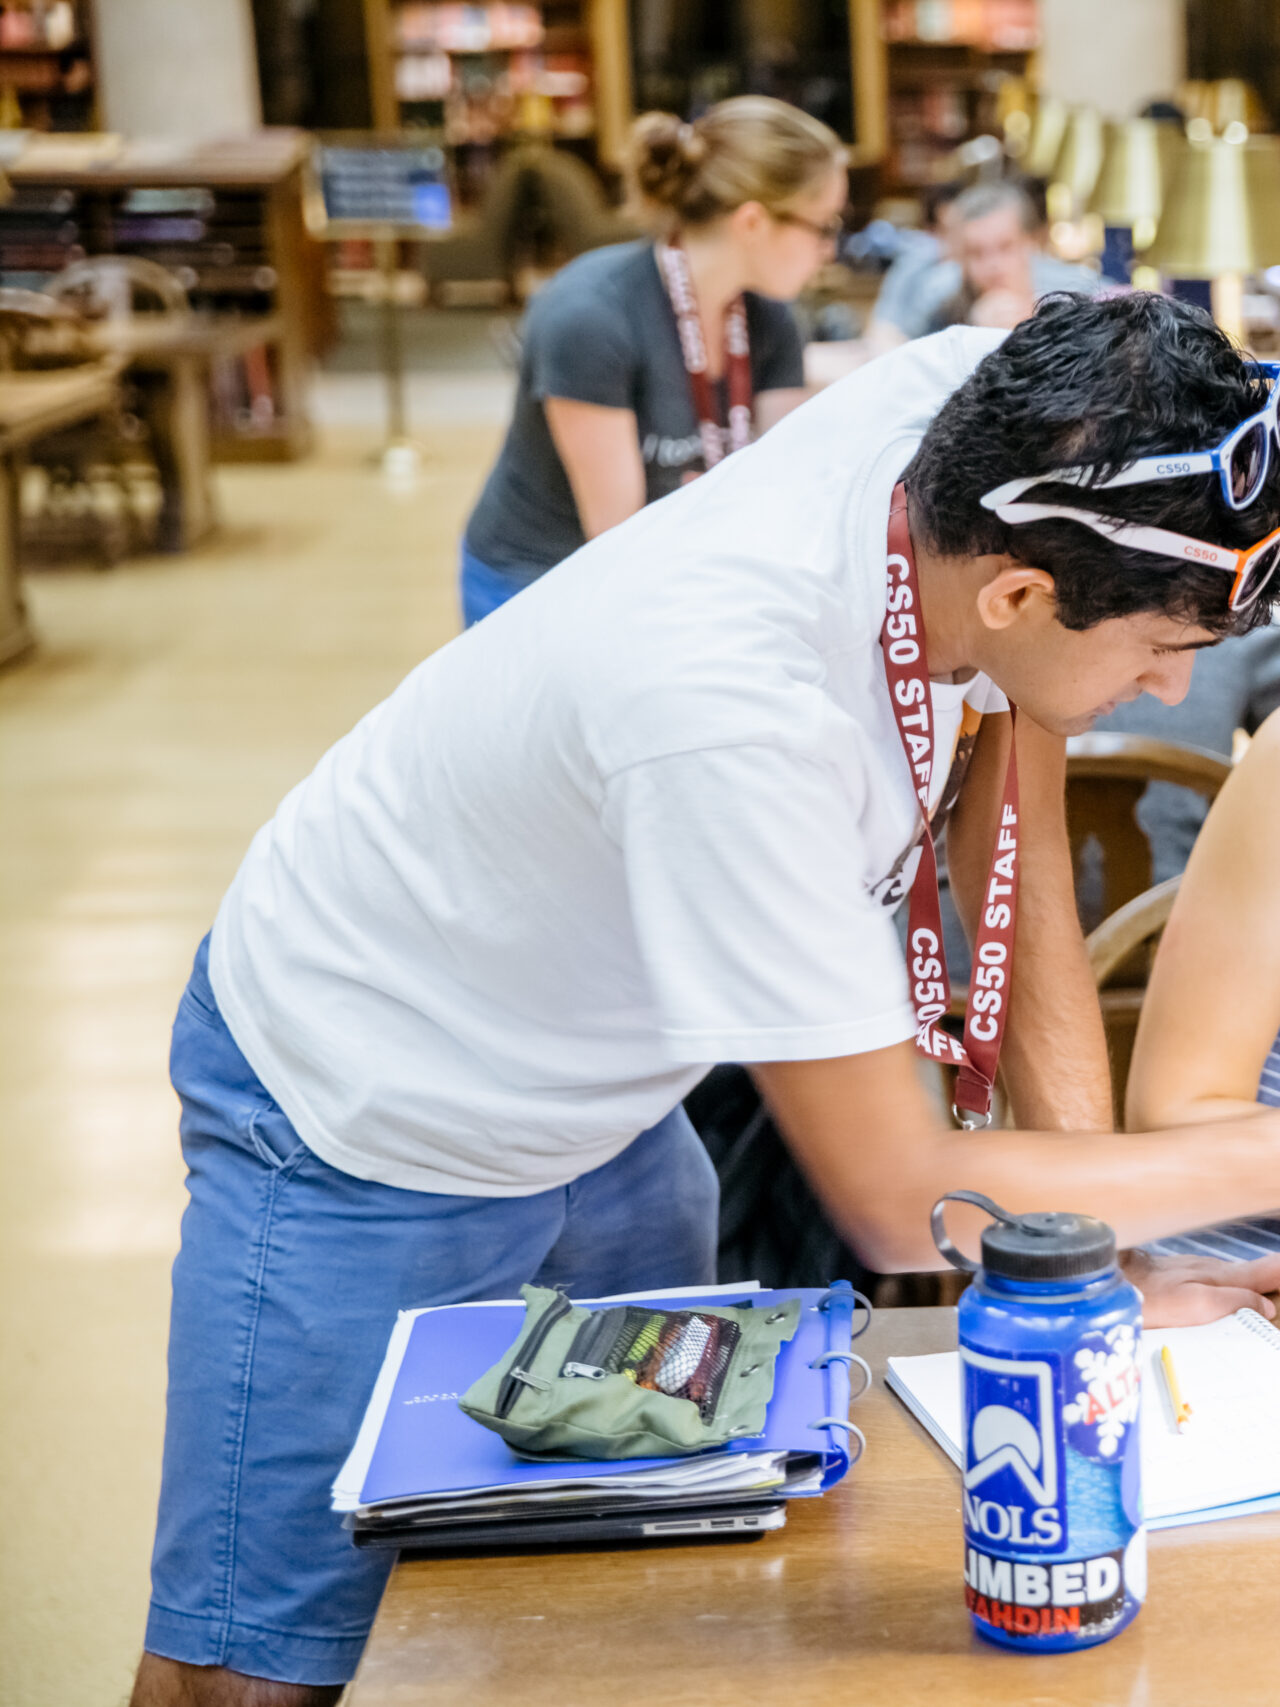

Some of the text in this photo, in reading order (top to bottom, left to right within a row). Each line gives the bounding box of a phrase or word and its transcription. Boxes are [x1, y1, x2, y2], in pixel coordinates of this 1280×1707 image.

[1156, 462, 1191, 474] CS50
[1183, 545, 1218, 562] CS50
[885, 553, 920, 666] CS50
[969, 803, 1017, 1042] CS50 STAFF
[911, 927, 967, 1060] CS50 AFF
[964, 1489, 1062, 1546] NOLS
[964, 1547, 1120, 1607] IMBED
